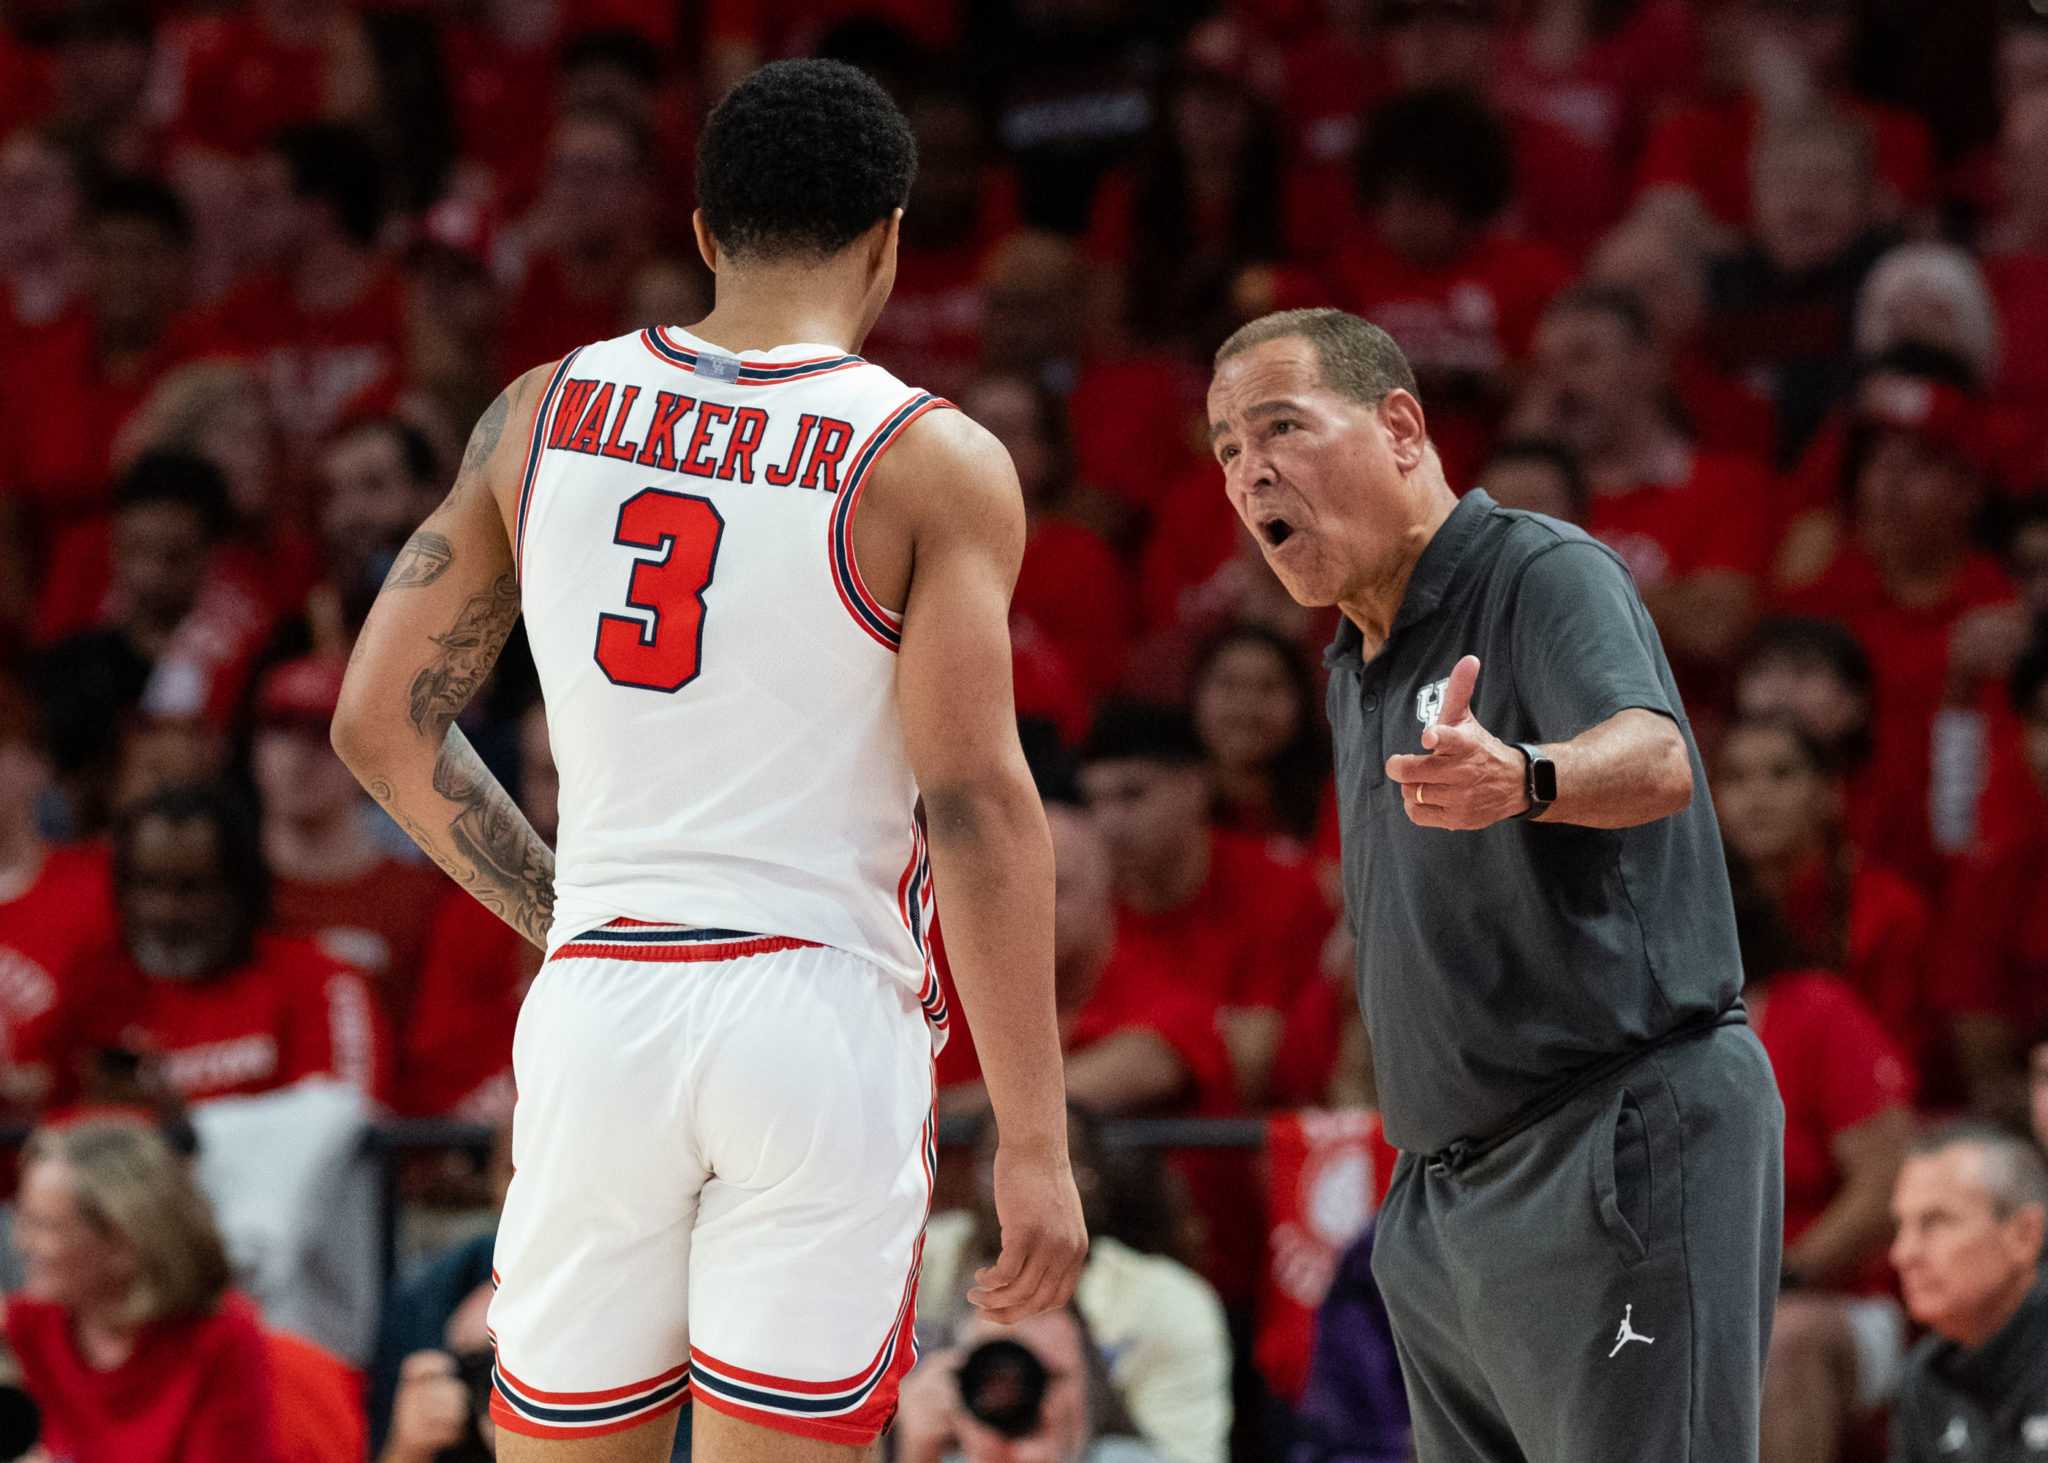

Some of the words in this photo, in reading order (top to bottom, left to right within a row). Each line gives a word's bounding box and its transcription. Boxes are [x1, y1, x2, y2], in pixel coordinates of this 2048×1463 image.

[547, 378, 768, 484] WALKER
[765, 413, 854, 493] JR
[594, 487, 725, 694] 3
